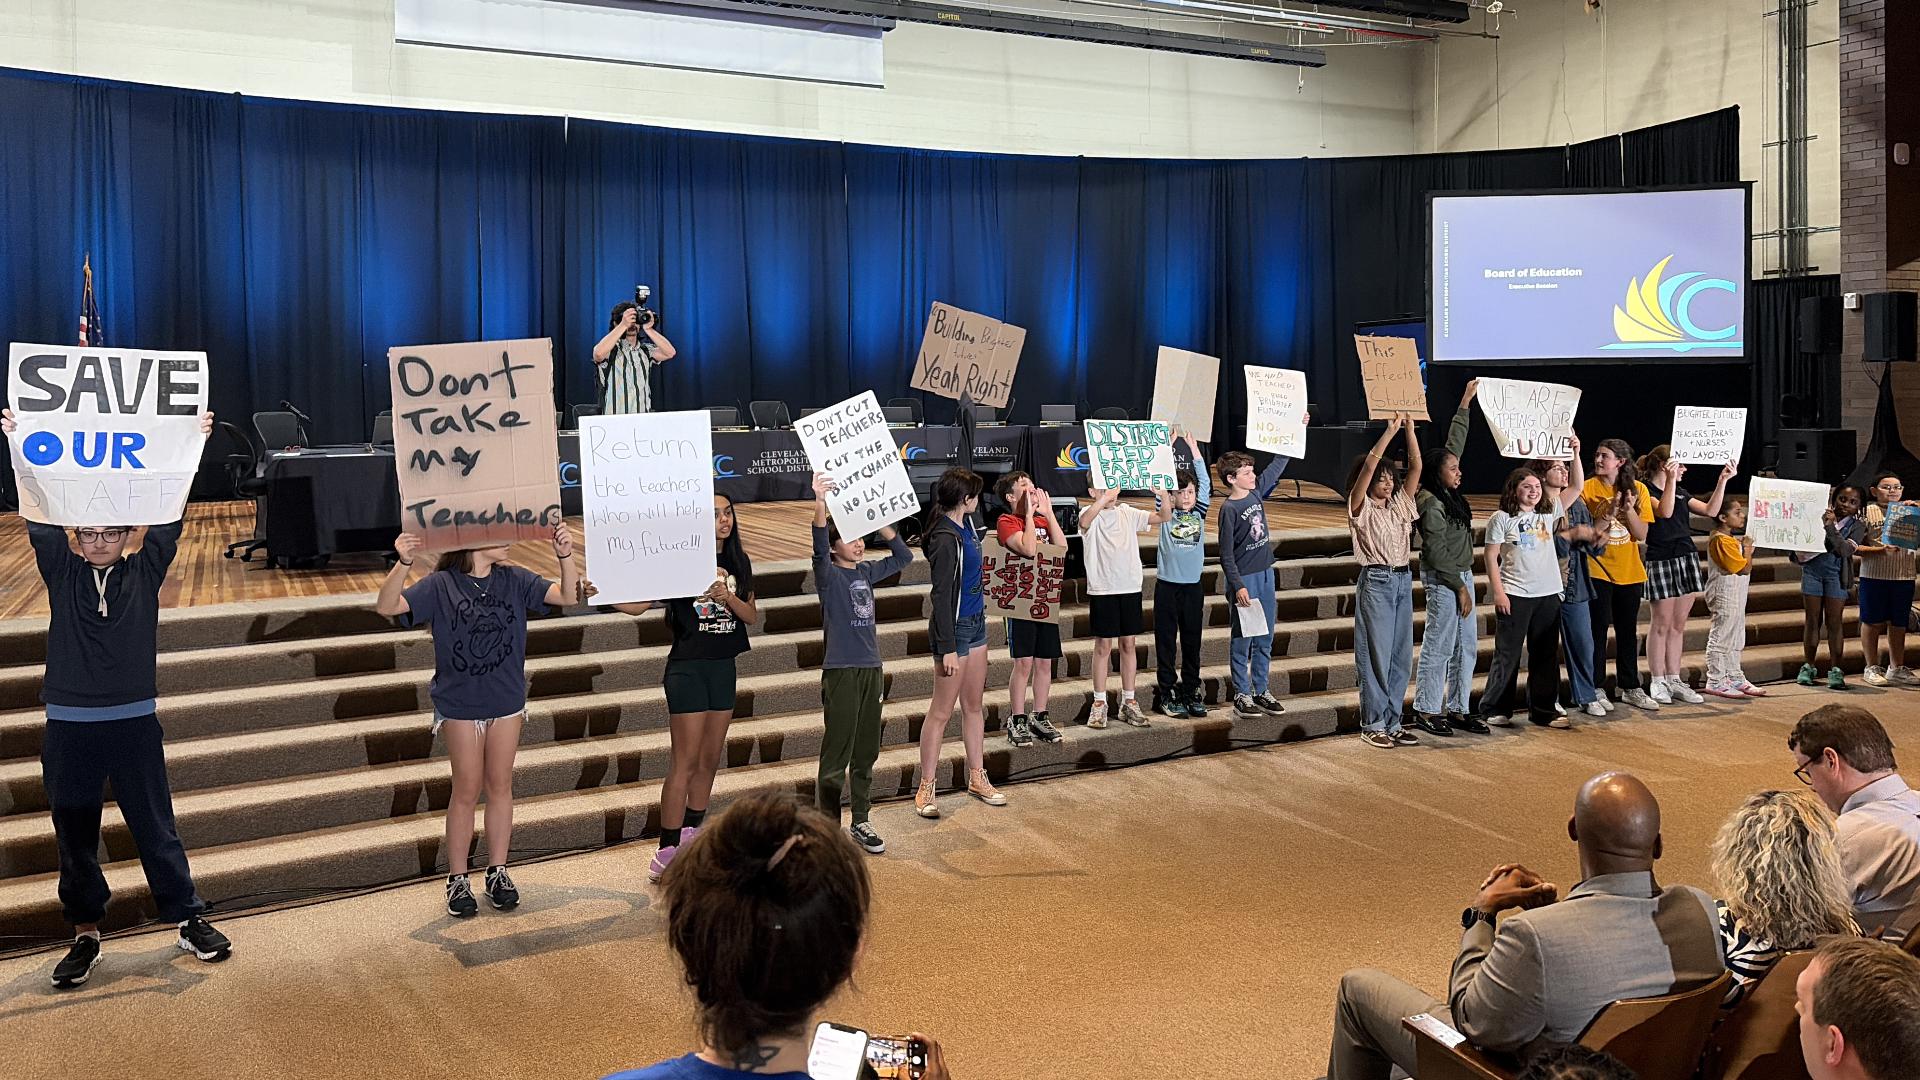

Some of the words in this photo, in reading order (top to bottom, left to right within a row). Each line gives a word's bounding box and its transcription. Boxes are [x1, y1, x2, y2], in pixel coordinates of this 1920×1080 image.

[1484, 268, 1515, 278] Board
[1517, 268, 1528, 277] of
[1529, 267, 1582, 277] Education
[1359, 340, 1395, 358] This
[18, 354, 200, 416] SAVE
[397, 351, 535, 399] Dont
[920, 352, 961, 393] Yeah
[964, 363, 1011, 402] Right
[1483, 381, 1517, 411] WE
[1527, 385, 1567, 415] ARE
[401, 402, 531, 435] Take
[803, 411, 843, 437] DON'T
[846, 398, 869, 417] CUT
[1677, 408, 1710, 419] BRIGHTER
[1714, 410, 1743, 419] FUTURES
[820, 412, 883, 447] TEACHERS
[1087, 422, 1170, 446] DISTRICT
[1696, 439, 1726, 447] NURSES
[1711, 429, 1734, 438] PARAS
[22, 431, 146, 469] OUR
[590, 426, 698, 466] Return
[761, 450, 808, 459] CLEVELAN
[824, 452, 849, 471] CUT
[855, 440, 883, 459] THE
[1097, 445, 1155, 463] LIED
[1674, 450, 1688, 459] NO
[747, 466, 784, 475] SCHOOL
[752, 457, 810, 467] METROPOLIT
[1100, 460, 1150, 480] FAPE
[19, 476, 184, 512] STAFF
[594, 475, 629, 497] the
[639, 476, 701, 494] teachers
[1105, 474, 1175, 490] DENIED
[676, 499, 702, 519] help
[842, 497, 860, 514] NO
[863, 480, 887, 503] LAY
[867, 492, 916, 521] OFFS!
[1754, 499, 1805, 519] Brighter
[607, 536, 635, 563] my
[998, 553, 1021, 610] RIGHT
[1018, 563, 1034, 600] NOT
[1030, 552, 1053, 620] BUDGET
